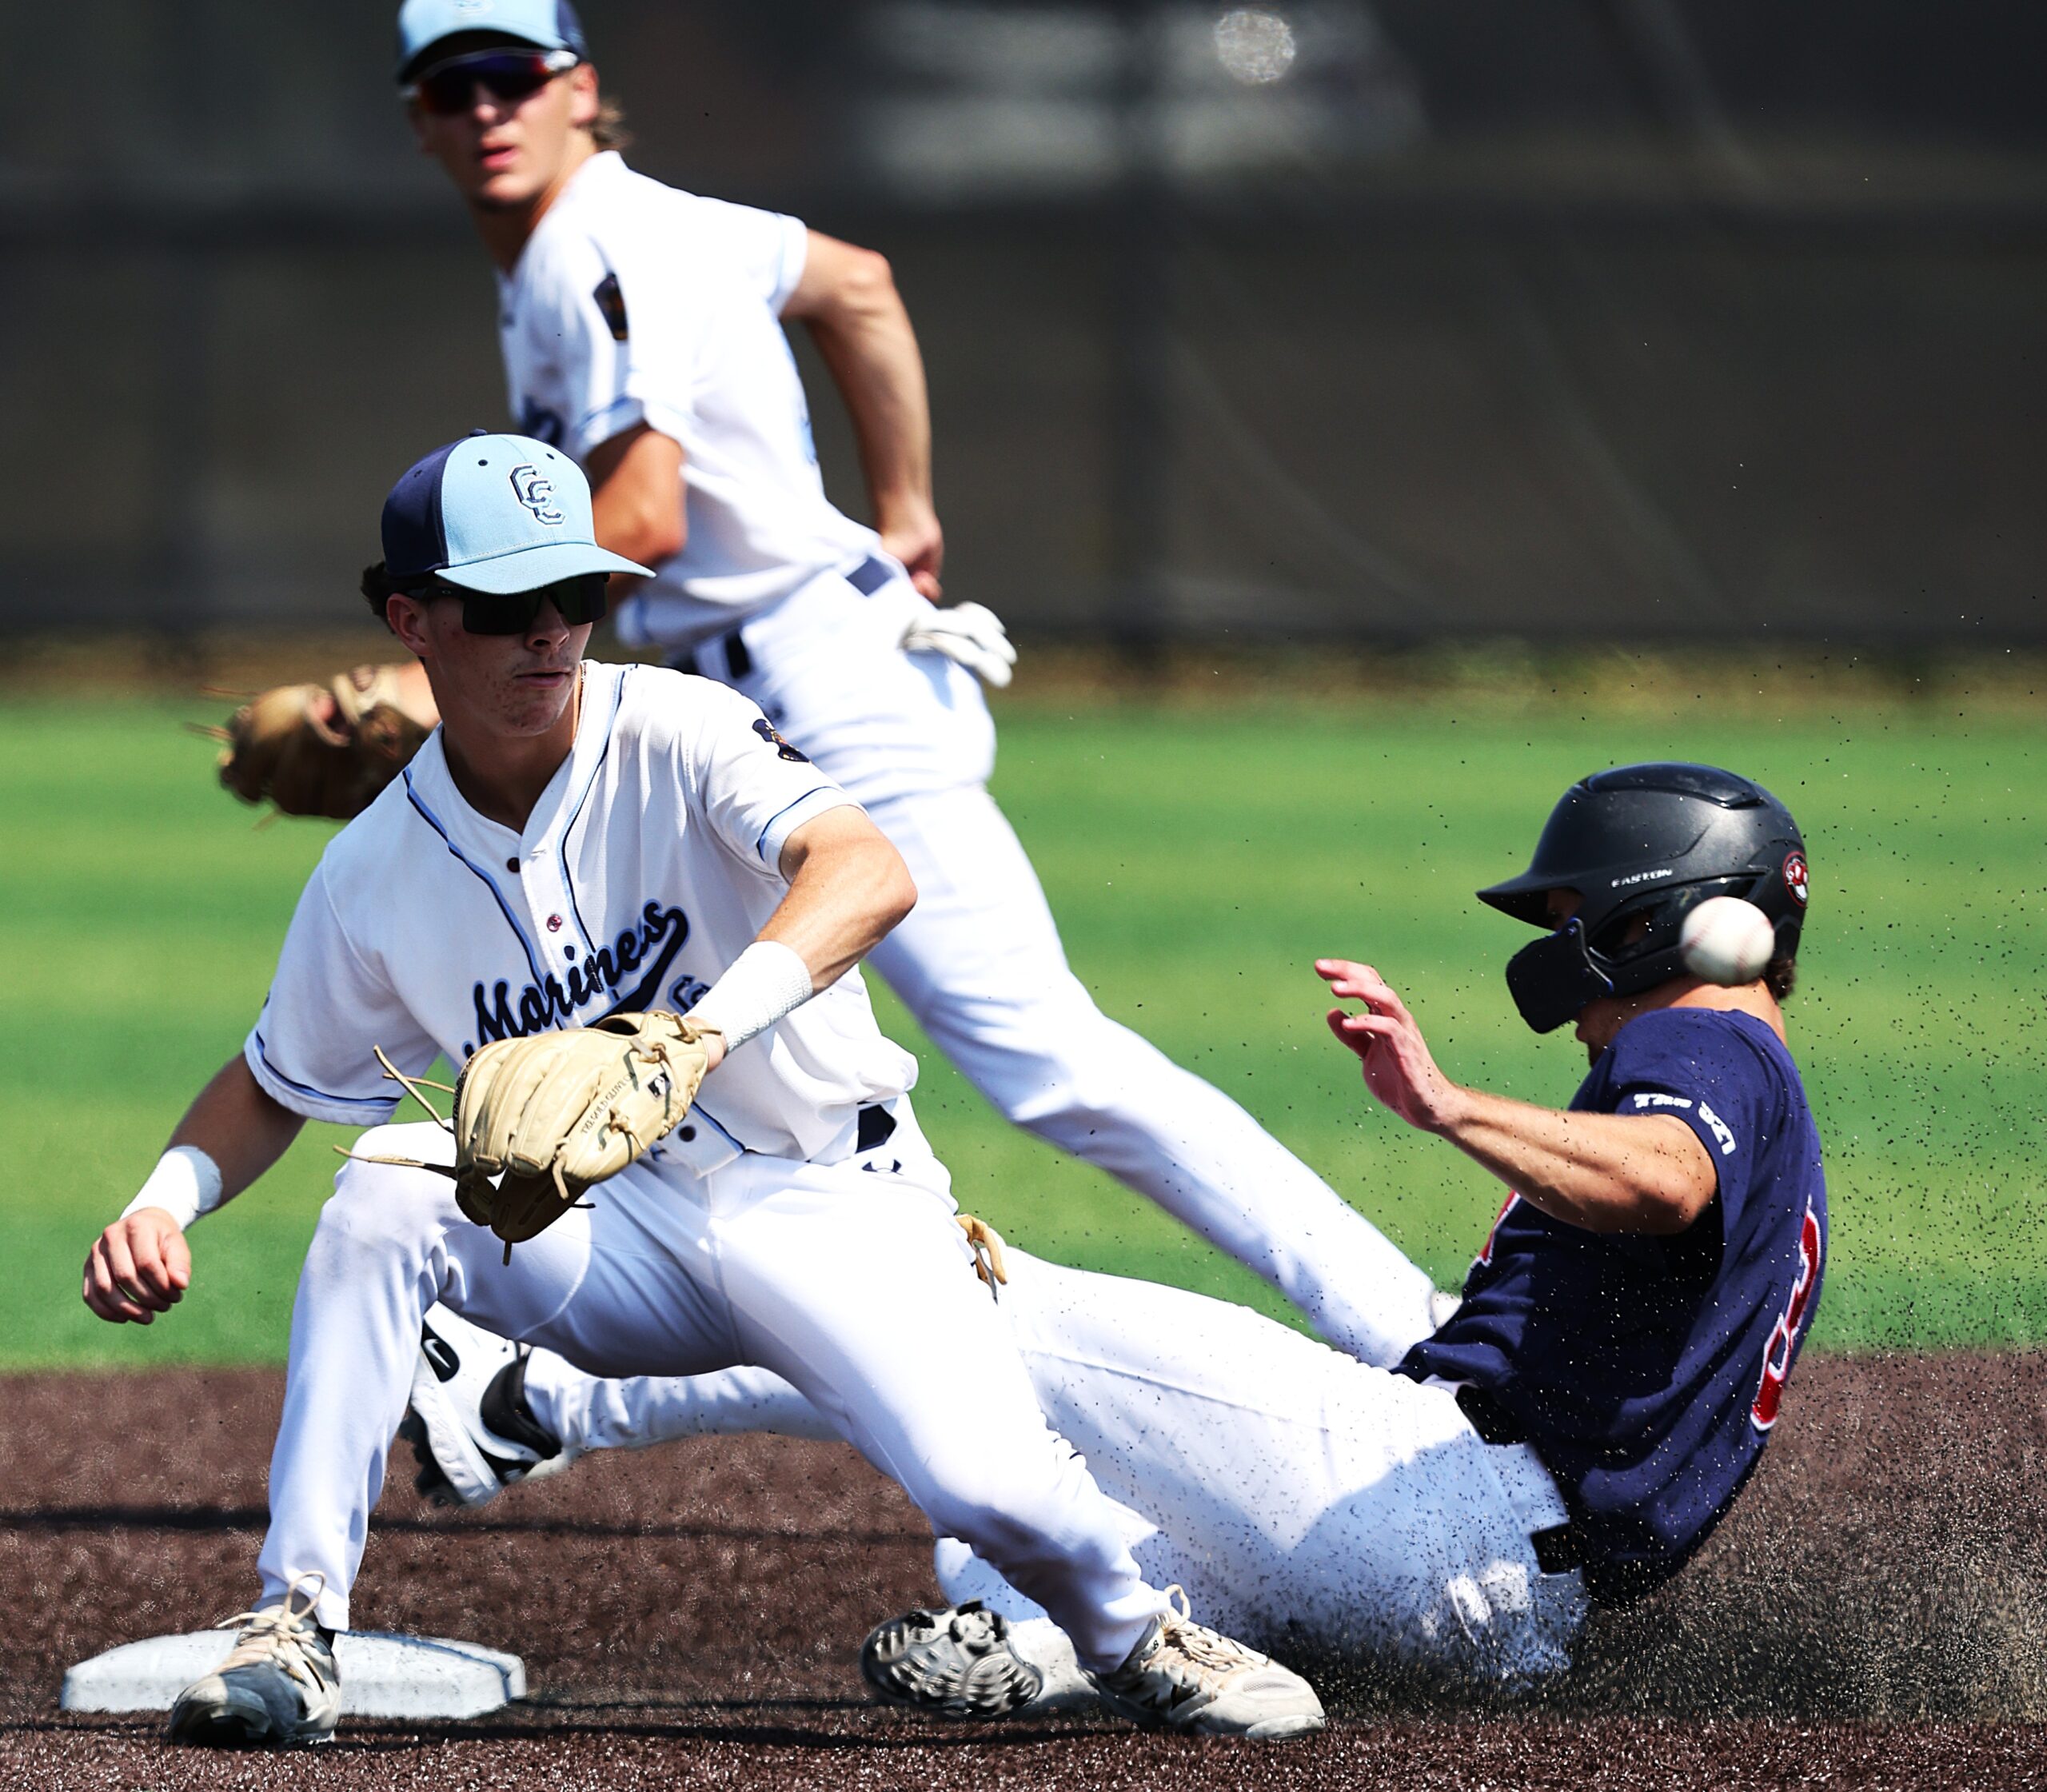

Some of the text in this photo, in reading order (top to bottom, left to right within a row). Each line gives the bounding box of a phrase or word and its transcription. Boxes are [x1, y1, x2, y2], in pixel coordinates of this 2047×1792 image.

[509, 464, 566, 525] CC
[1611, 868, 1674, 888] EASTON
[462, 900, 690, 1056] Marines
